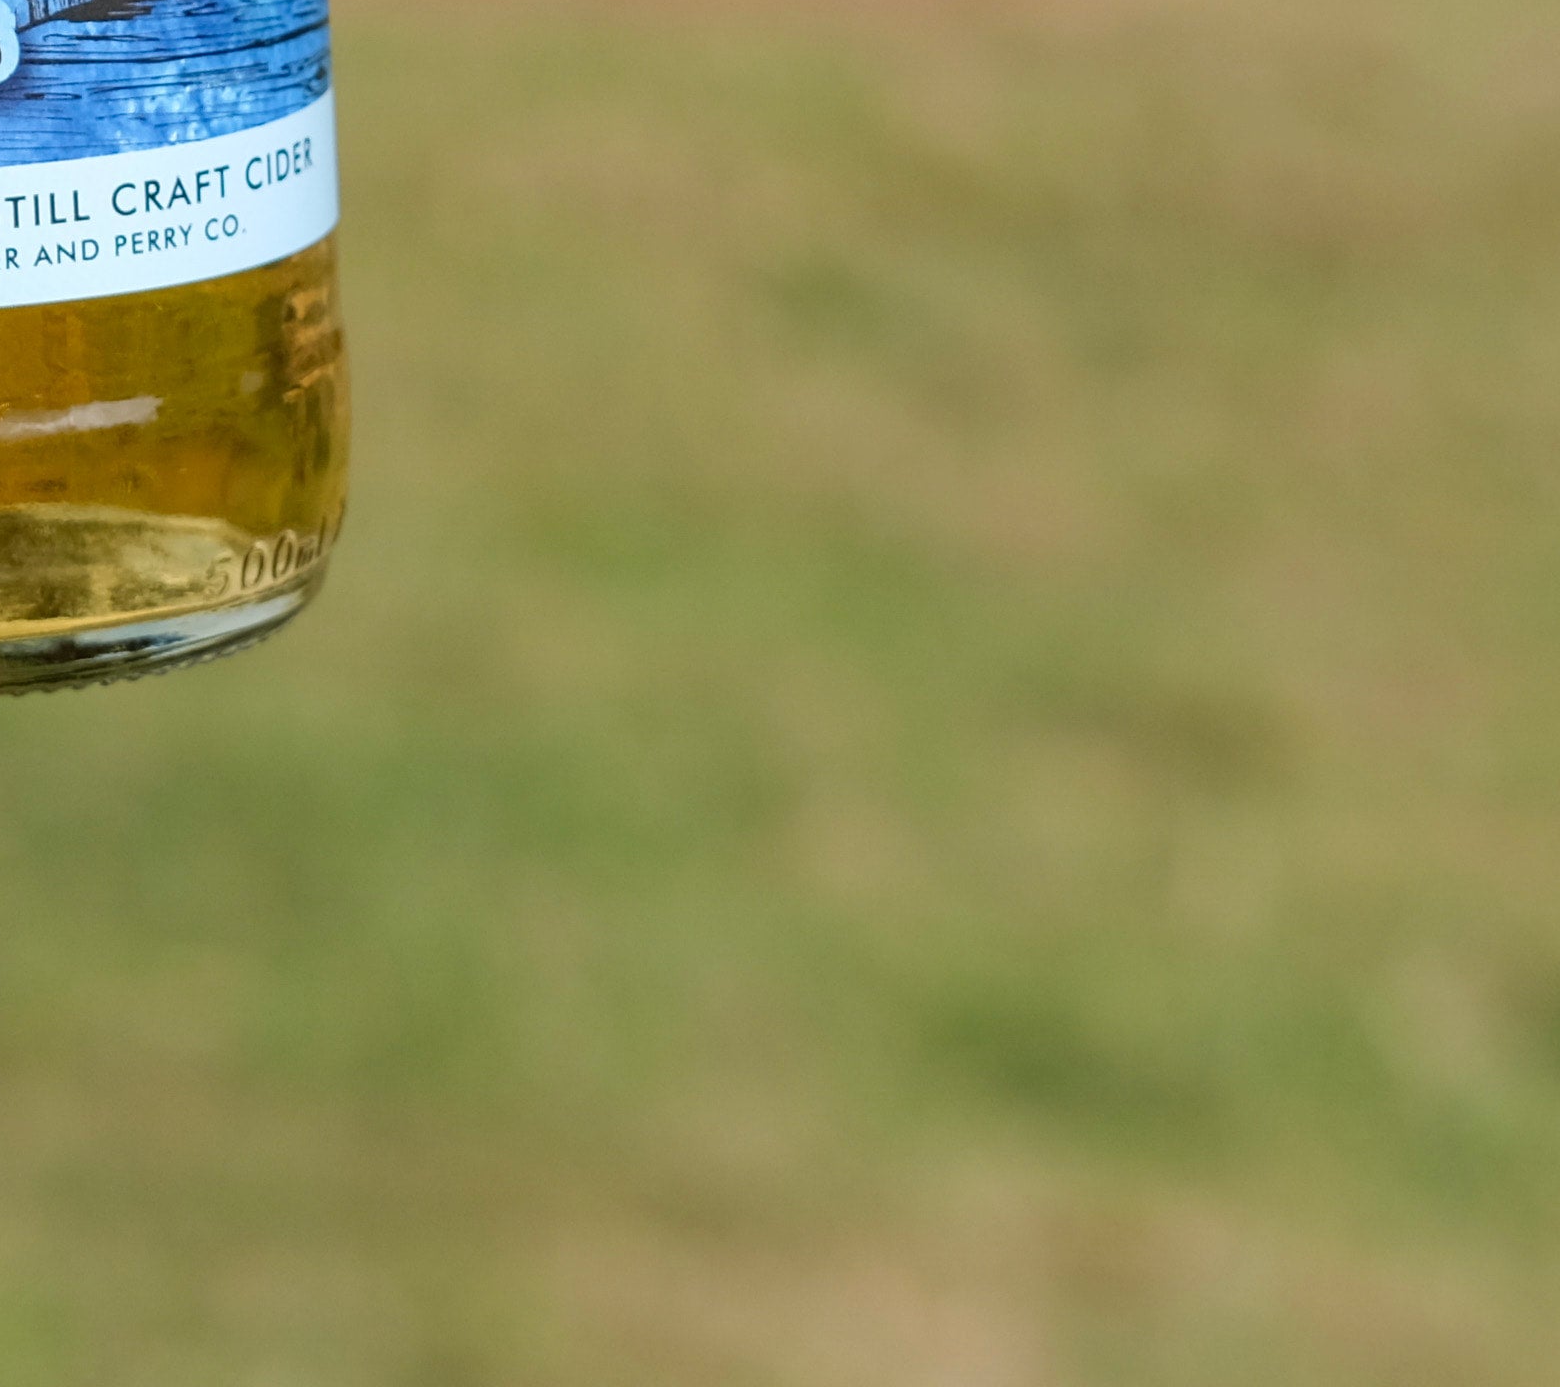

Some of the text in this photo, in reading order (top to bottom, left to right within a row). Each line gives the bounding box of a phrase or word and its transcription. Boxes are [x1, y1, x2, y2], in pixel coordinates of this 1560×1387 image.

[111, 165, 230, 217] CRAFT
[245, 137, 313, 191] CIDER
[33, 238, 101, 267] AND
[115, 224, 193, 257] PERRY
[205, 213, 247, 242] CO.
